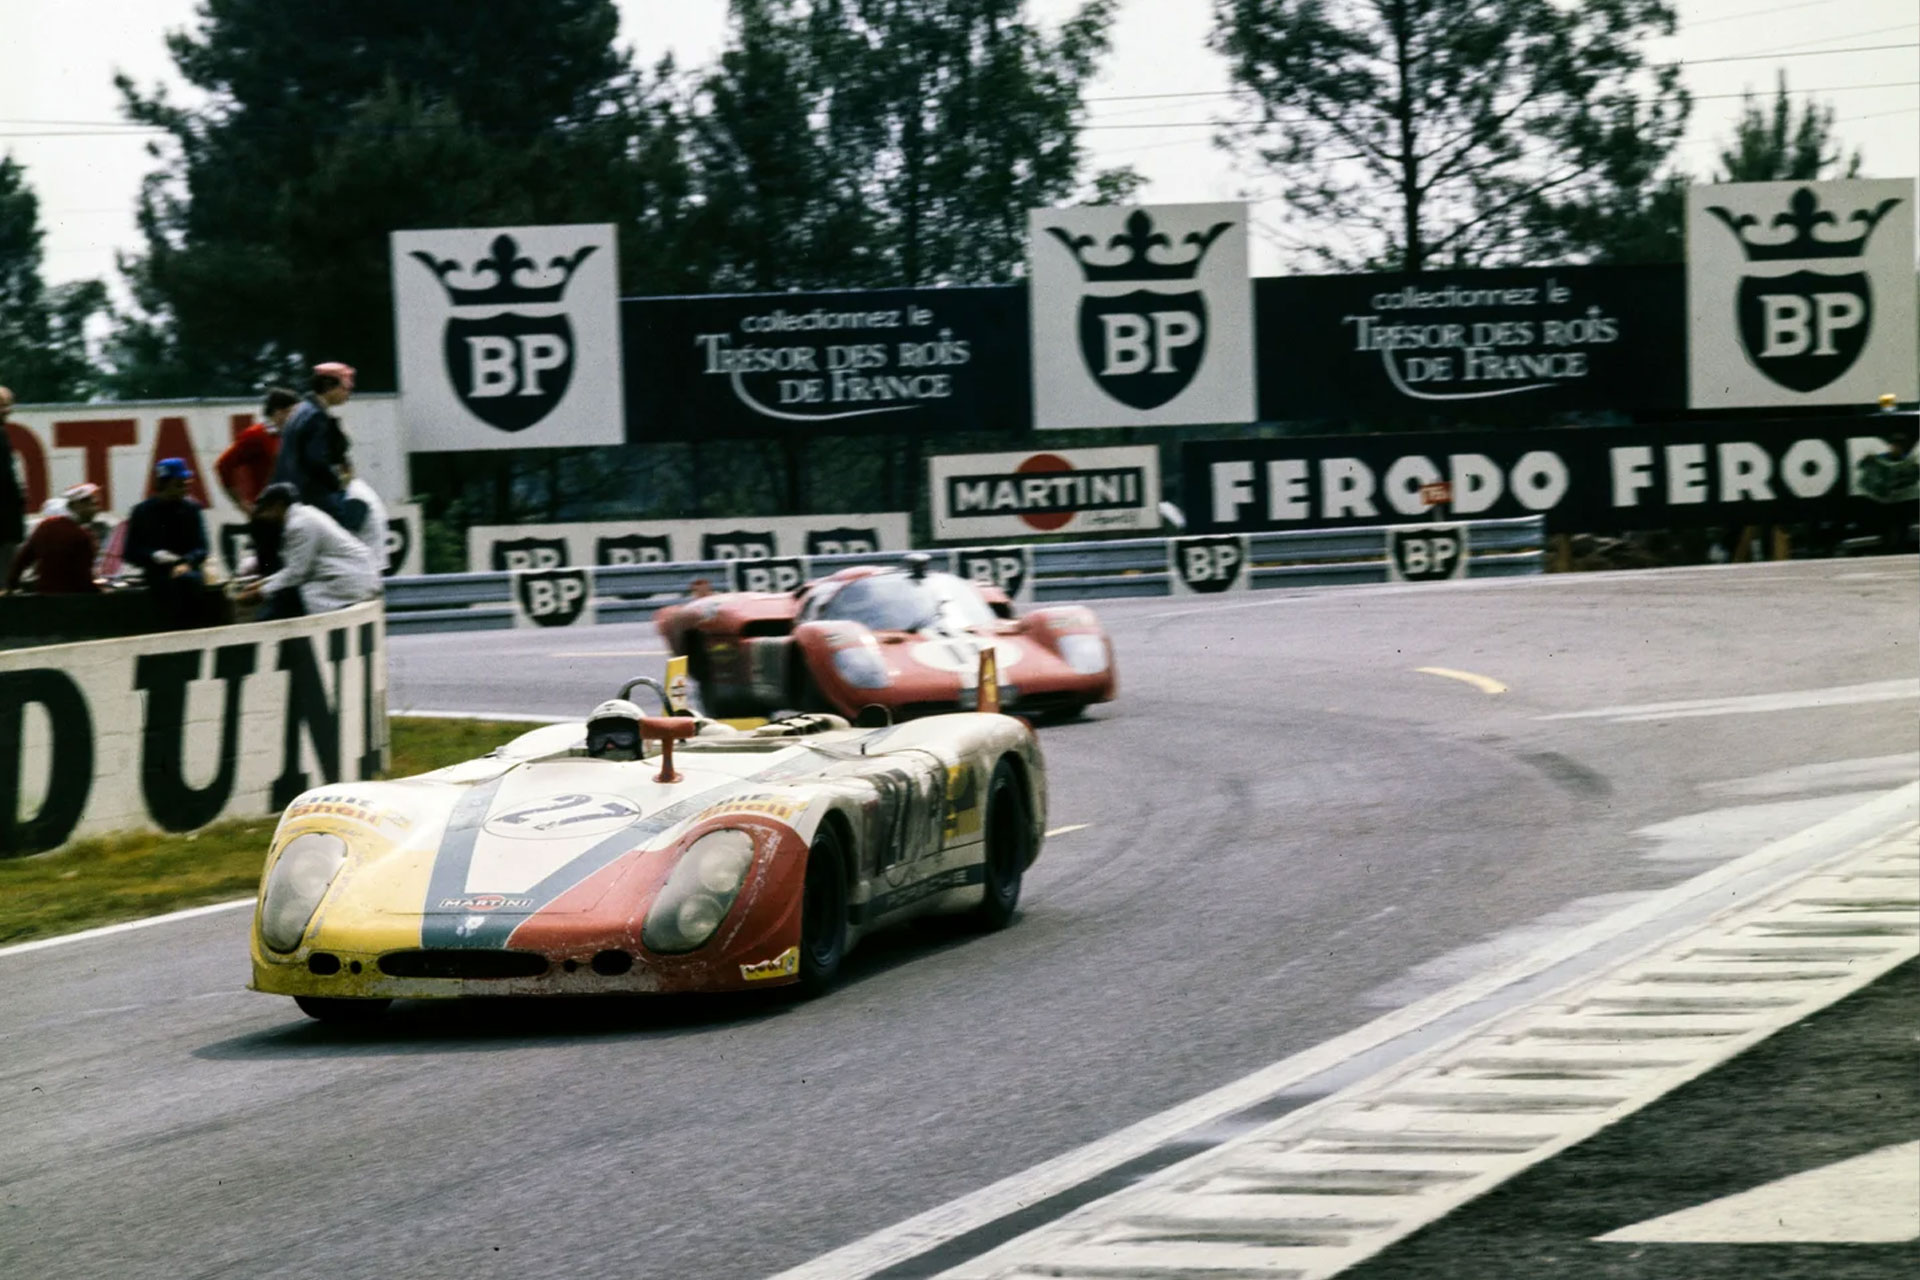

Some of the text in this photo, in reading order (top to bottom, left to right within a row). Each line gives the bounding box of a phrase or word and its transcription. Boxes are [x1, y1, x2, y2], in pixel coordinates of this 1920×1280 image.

[1547, 278, 1571, 304] le
[907, 304, 935, 326] le
[1757, 292, 1865, 358] BP
[1099, 310, 1200, 377] BP
[1472, 321, 1536, 347] DES
[465, 333, 568, 398] BP
[825, 343, 888, 370] DES
[1405, 347, 1590, 383] DE FRANCE
[778, 369, 951, 404] DE FRANCE
[955, 473, 1138, 511] MARTINI
[1210, 450, 1569, 523] FERODO
[1185, 543, 1241, 582] BP
[1402, 537, 1459, 574] BP
[529, 578, 583, 617] BP
[442, 898, 532, 908] MARTINI
